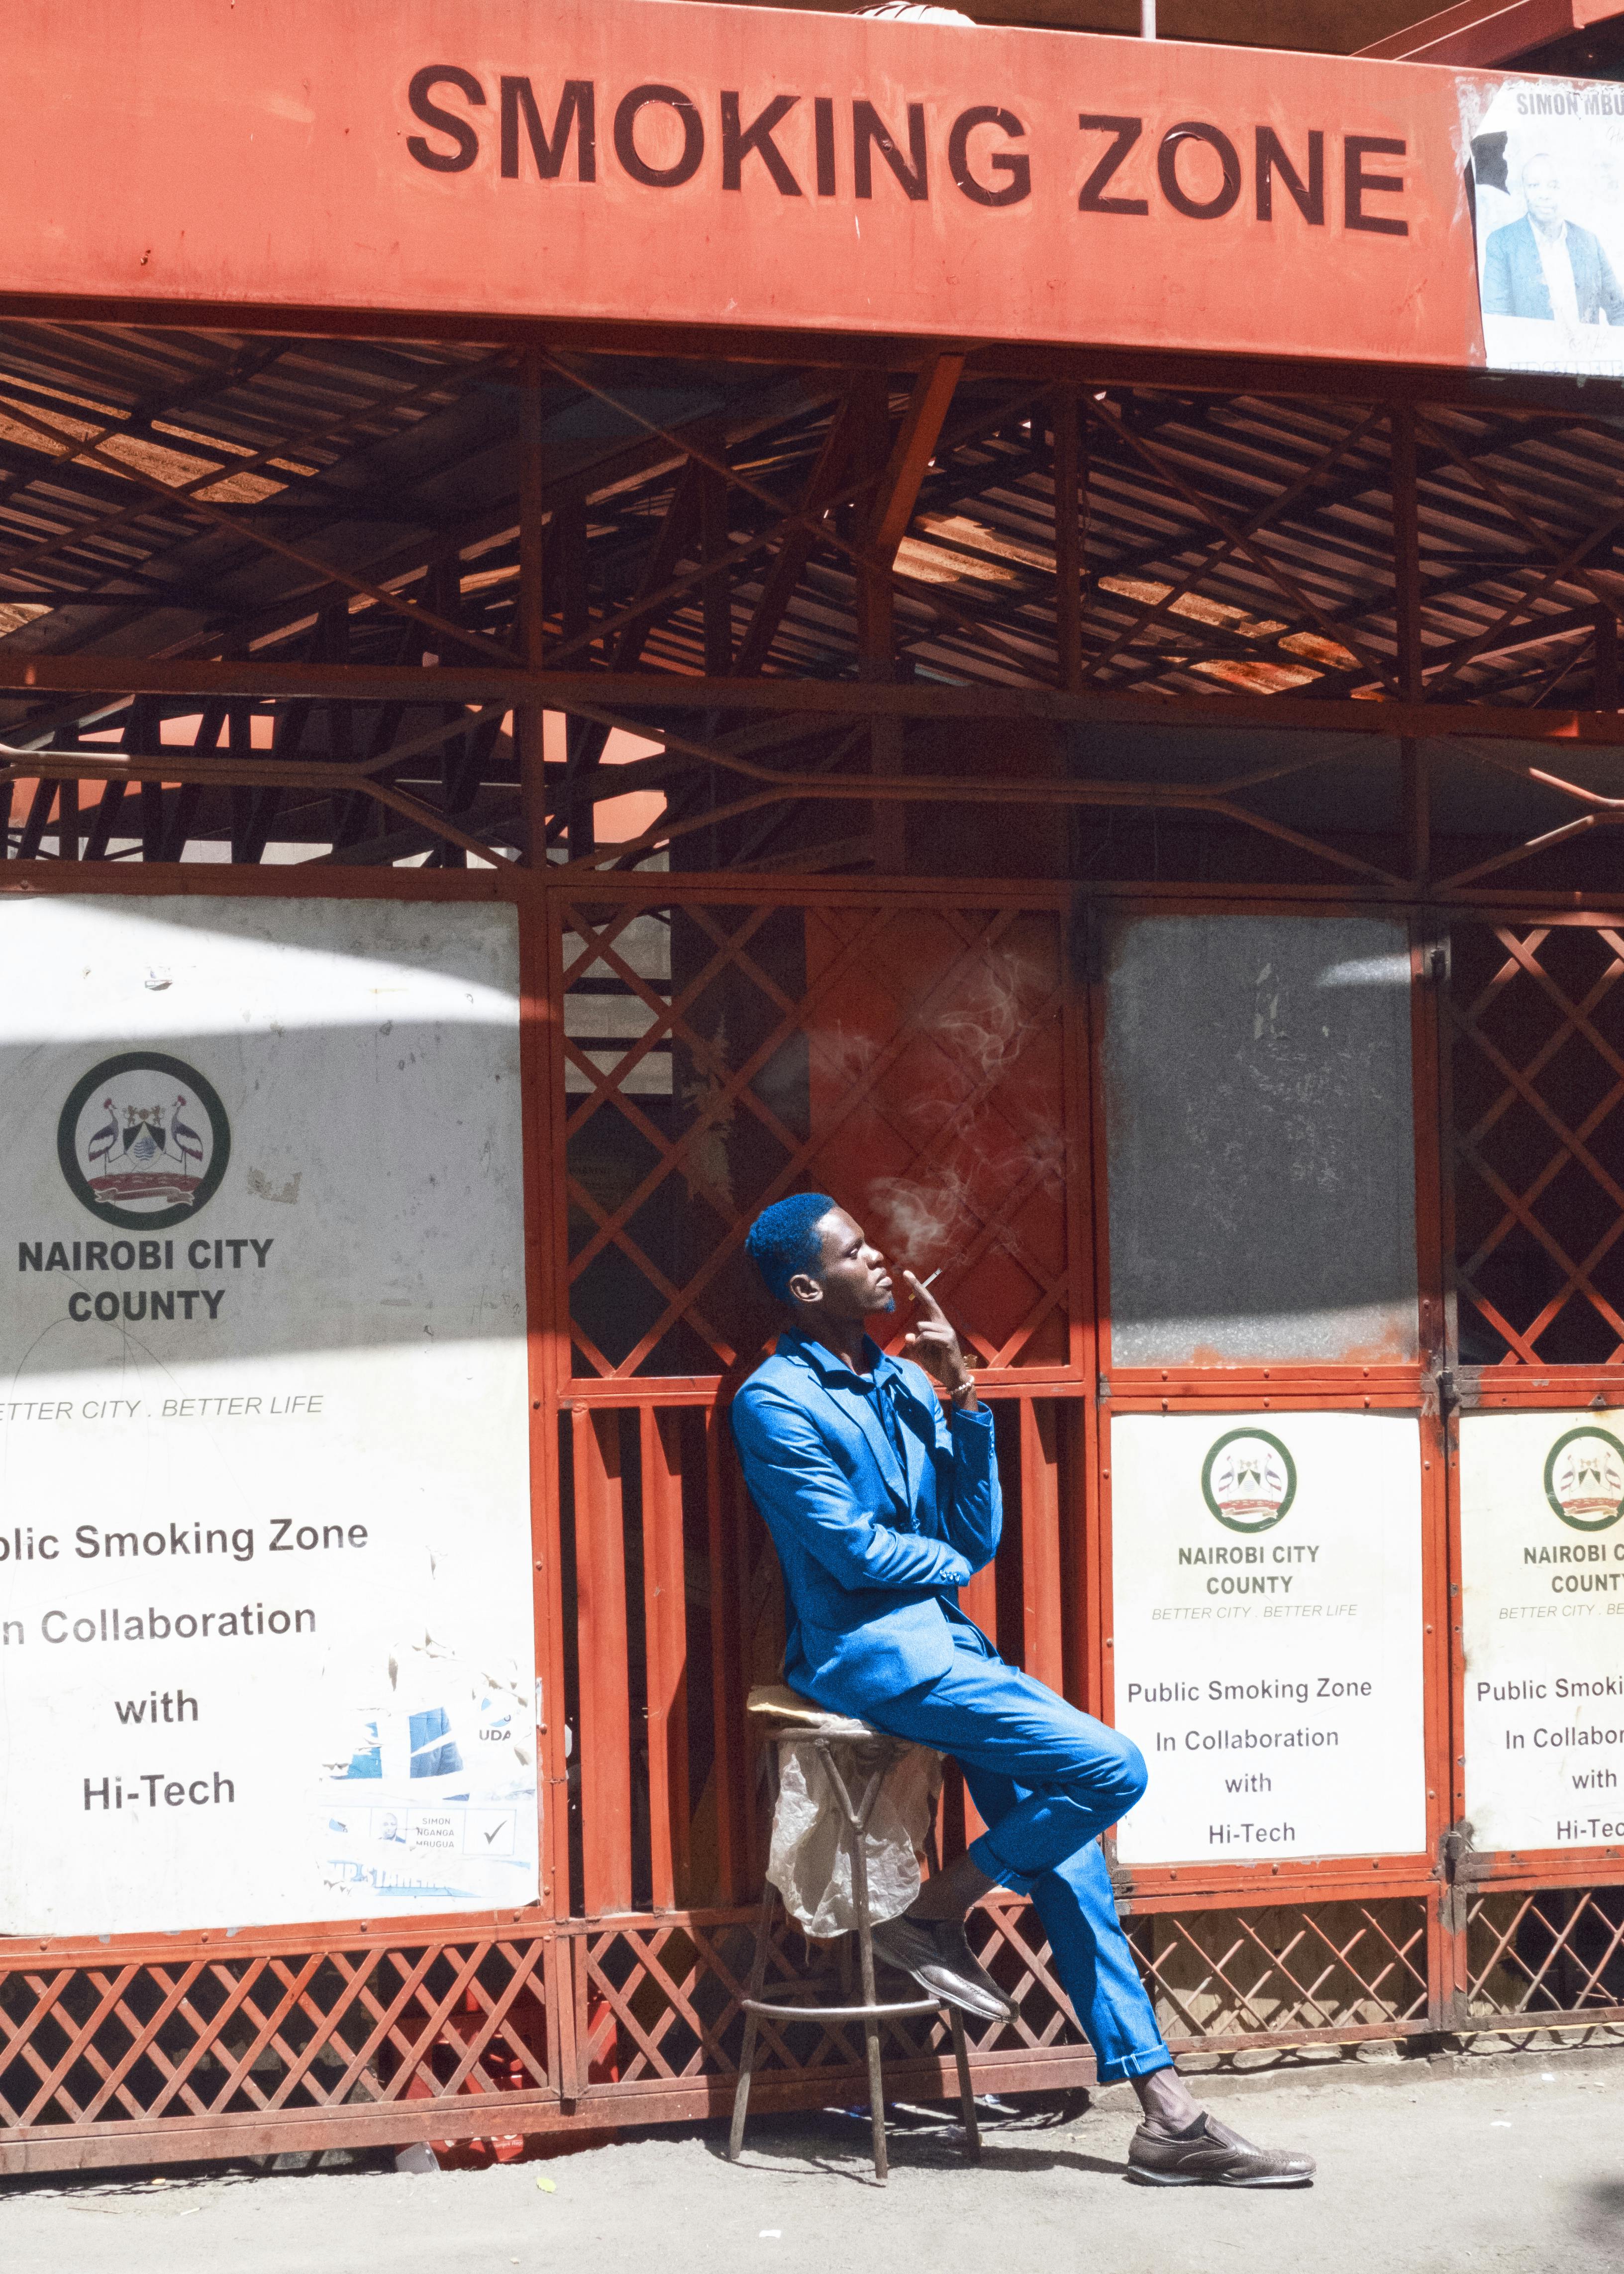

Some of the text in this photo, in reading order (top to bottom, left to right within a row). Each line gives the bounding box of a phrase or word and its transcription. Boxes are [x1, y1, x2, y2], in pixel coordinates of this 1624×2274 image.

[1517, 93, 1578, 115] SIMON
[406, 64, 1409, 236] SMOKING ZONE
[19, 1239, 274, 1271] NAIROBI CITY
[69, 1290, 225, 1322] COUNTY
[83, 1400, 141, 1419] CITY
[162, 1397, 262, 1416] BETTER
[270, 1395, 323, 1414] LIFE
[76, 1522, 253, 1561] Smoking
[269, 1519, 368, 1550] Zone
[1179, 1546, 1319, 1564] NAIROBI CITY
[1524, 1545, 1606, 1564] NAIROBI
[1207, 1576, 1292, 1594] COUNTY
[1552, 1573, 1624, 1593] COUNT
[1152, 1608, 1212, 1620] BETTER
[1217, 1607, 1251, 1618] CITY
[1264, 1605, 1322, 1617] BETTER
[1326, 1604, 1357, 1616] LIFE
[1499, 1606, 1557, 1619] BETTER
[1562, 1605, 1595, 1617] CITY
[42, 1603, 315, 1643] Collaboration
[1128, 1678, 1371, 1703] Public Smoking Zone
[1478, 1680, 1546, 1701] Public
[115, 1690, 198, 1724] with
[480, 1730, 511, 1741] UDA
[1157, 1728, 1338, 1751] In Collaboration
[1507, 1731, 1524, 1749] In
[1225, 1773, 1271, 1792] with
[1572, 1769, 1617, 1789] with
[84, 1772, 234, 1810] Hi-Tech
[1210, 1823, 1295, 1844] Hi-Tech
